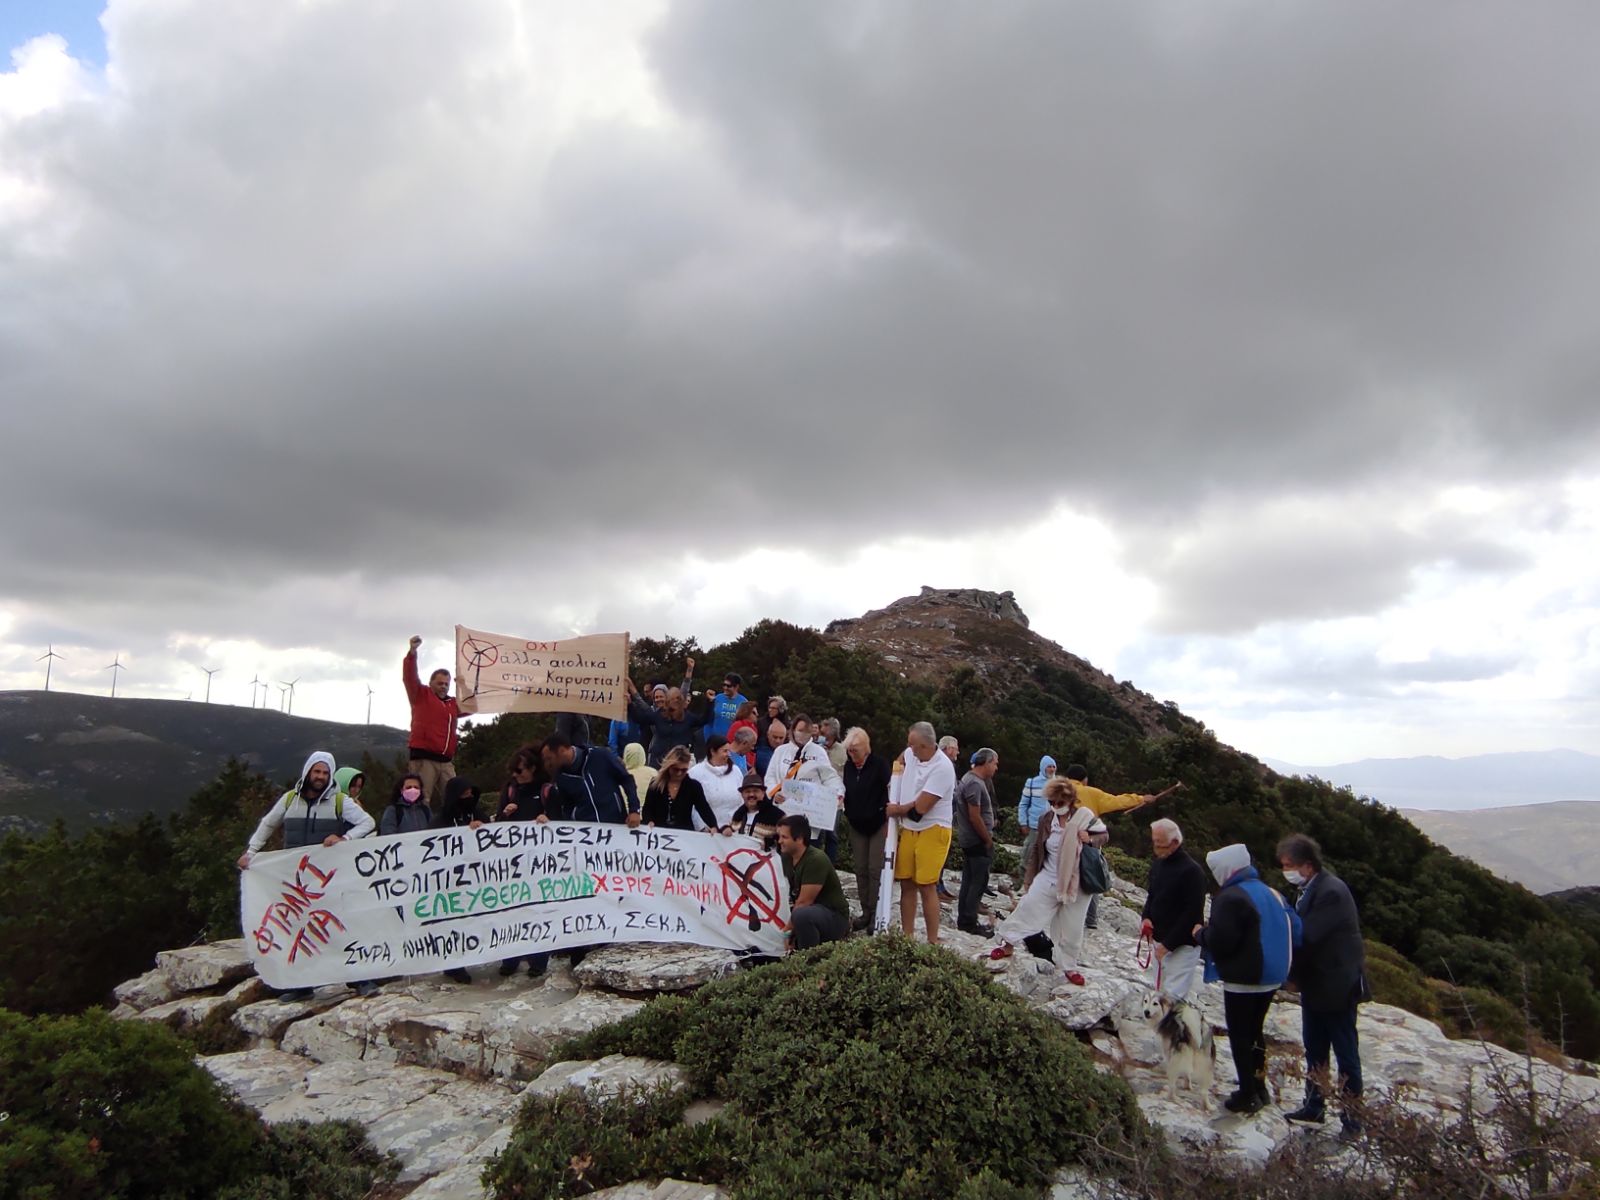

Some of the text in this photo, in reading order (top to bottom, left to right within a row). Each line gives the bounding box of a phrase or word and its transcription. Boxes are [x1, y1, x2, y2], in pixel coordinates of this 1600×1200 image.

[526, 641, 558, 652] ΟΧΙ
[355, 842, 404, 877] ΟΧΙ
[420, 834, 463, 864] ΣΤΗ
[629, 829, 680, 852] ΤΗΣ
[369, 853, 524, 900] ΠΟΛΙΤΙΣΤΙΚΗΣ
[531, 850, 571, 876] ΜΑΣ
[414, 881, 531, 918] ΕΛΕΥΘΕΡΑ
[538, 872, 594, 901] ΒΟΥΝΑ
[592, 873, 655, 897] ΧΩΡΙΣ
